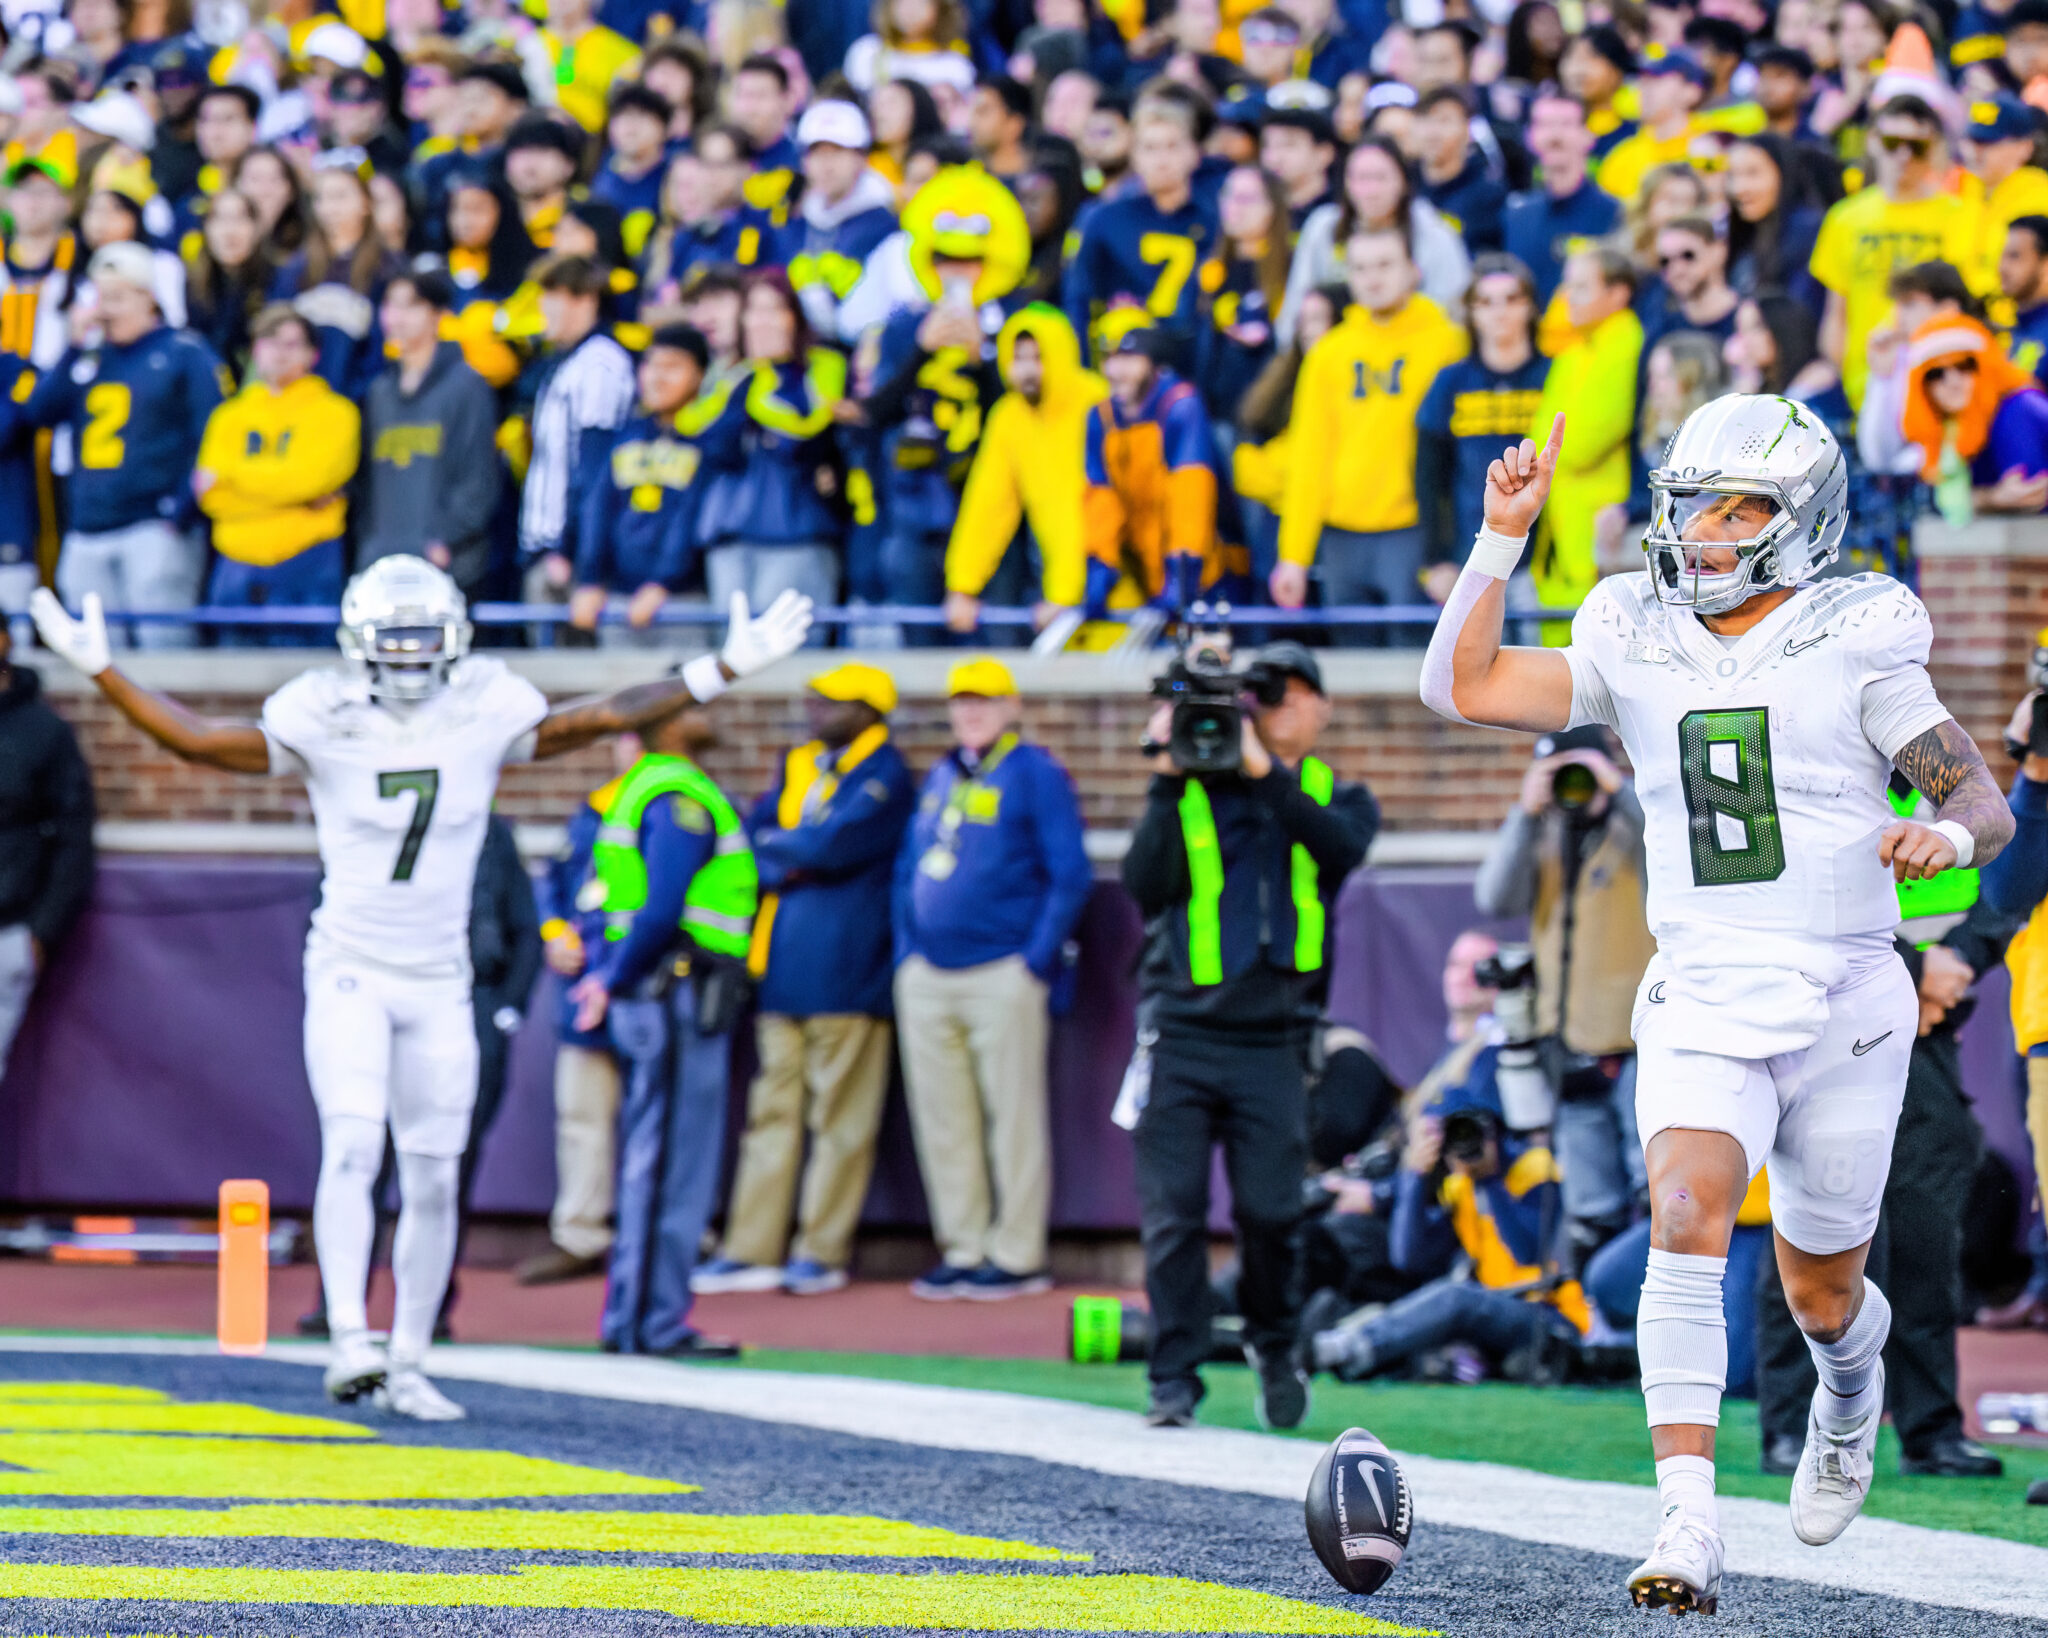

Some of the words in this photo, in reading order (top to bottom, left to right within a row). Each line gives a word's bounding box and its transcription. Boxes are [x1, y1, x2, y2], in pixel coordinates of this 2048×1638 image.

[1140, 233, 1195, 317] 7
[81, 382, 131, 468] 2
[1716, 657, 1738, 677] O
[376, 768, 439, 883] 7
[1678, 706, 1786, 886] 8
